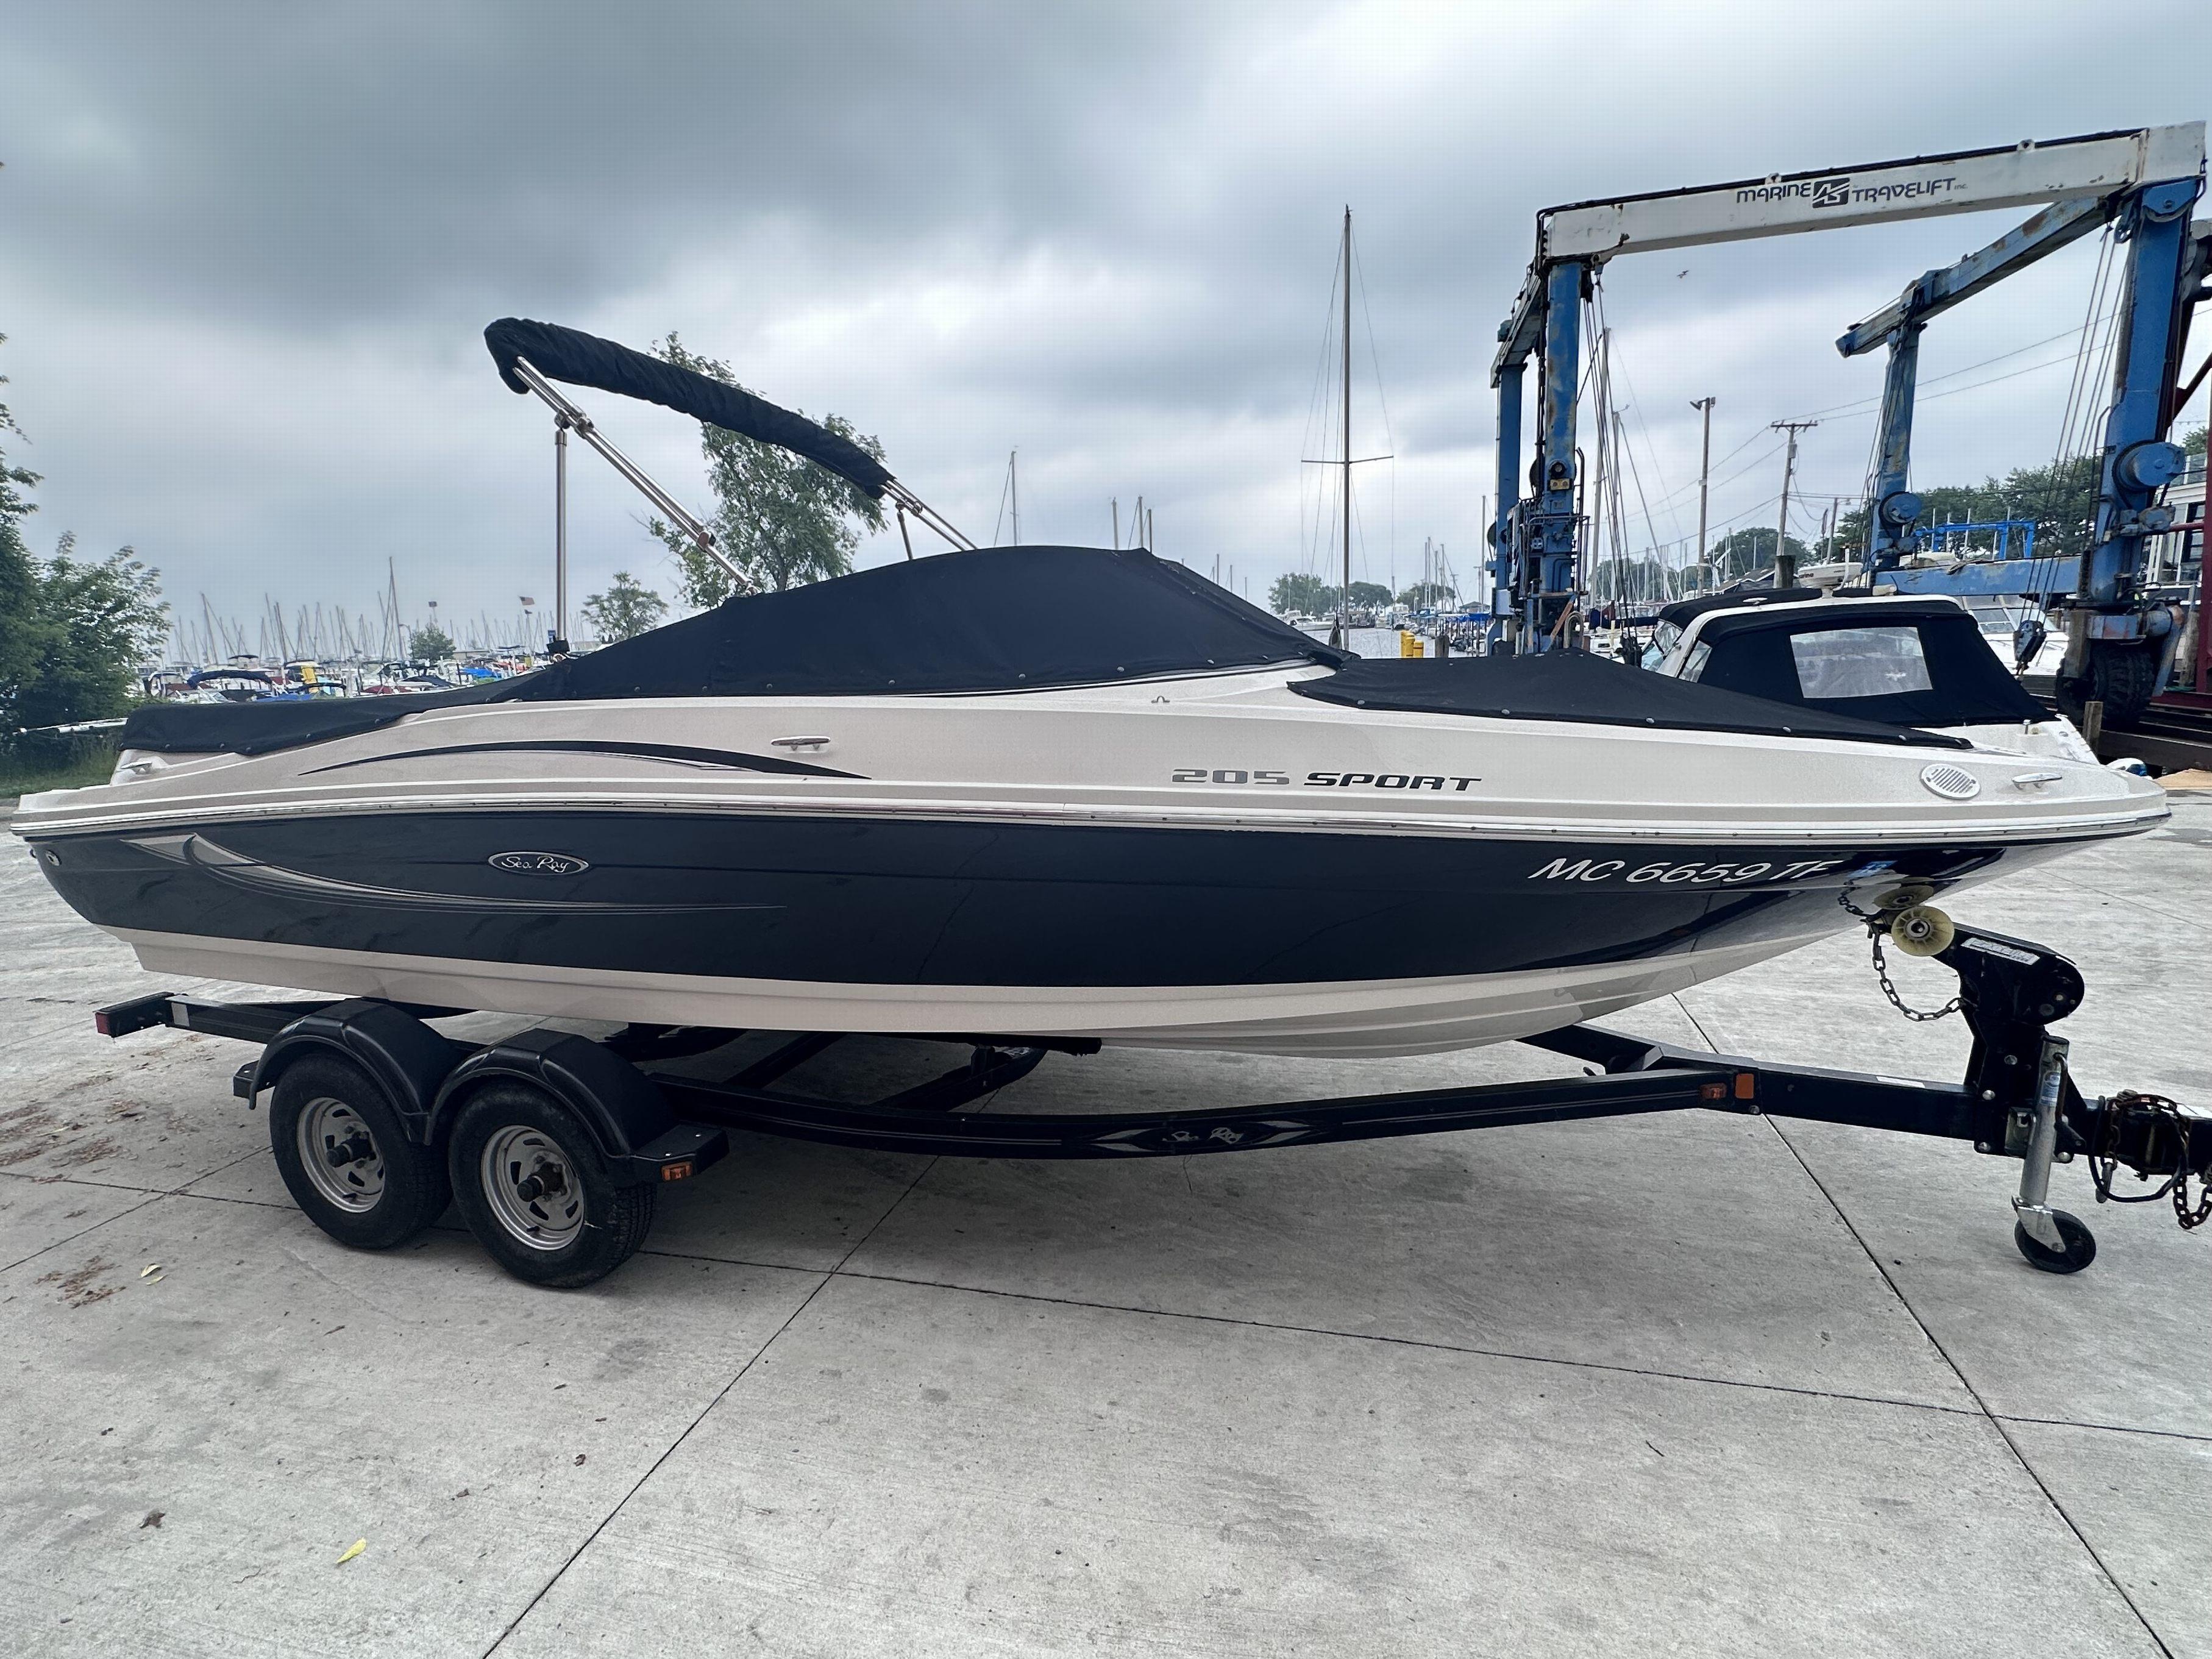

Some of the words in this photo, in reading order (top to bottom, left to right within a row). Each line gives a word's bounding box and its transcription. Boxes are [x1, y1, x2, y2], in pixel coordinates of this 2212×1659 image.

[1736, 182, 1812, 204] MARINE
[1851, 177, 1956, 202] TRAVELIFT
[1172, 768, 1290, 785] 205
[1303, 772, 1482, 791] SPORT
[501, 856, 532, 869] Sea
[536, 856, 570, 873] Ray
[1527, 858, 1626, 881] MC
[1625, 862, 1772, 883] 6659
[1768, 860, 1846, 879] TF
